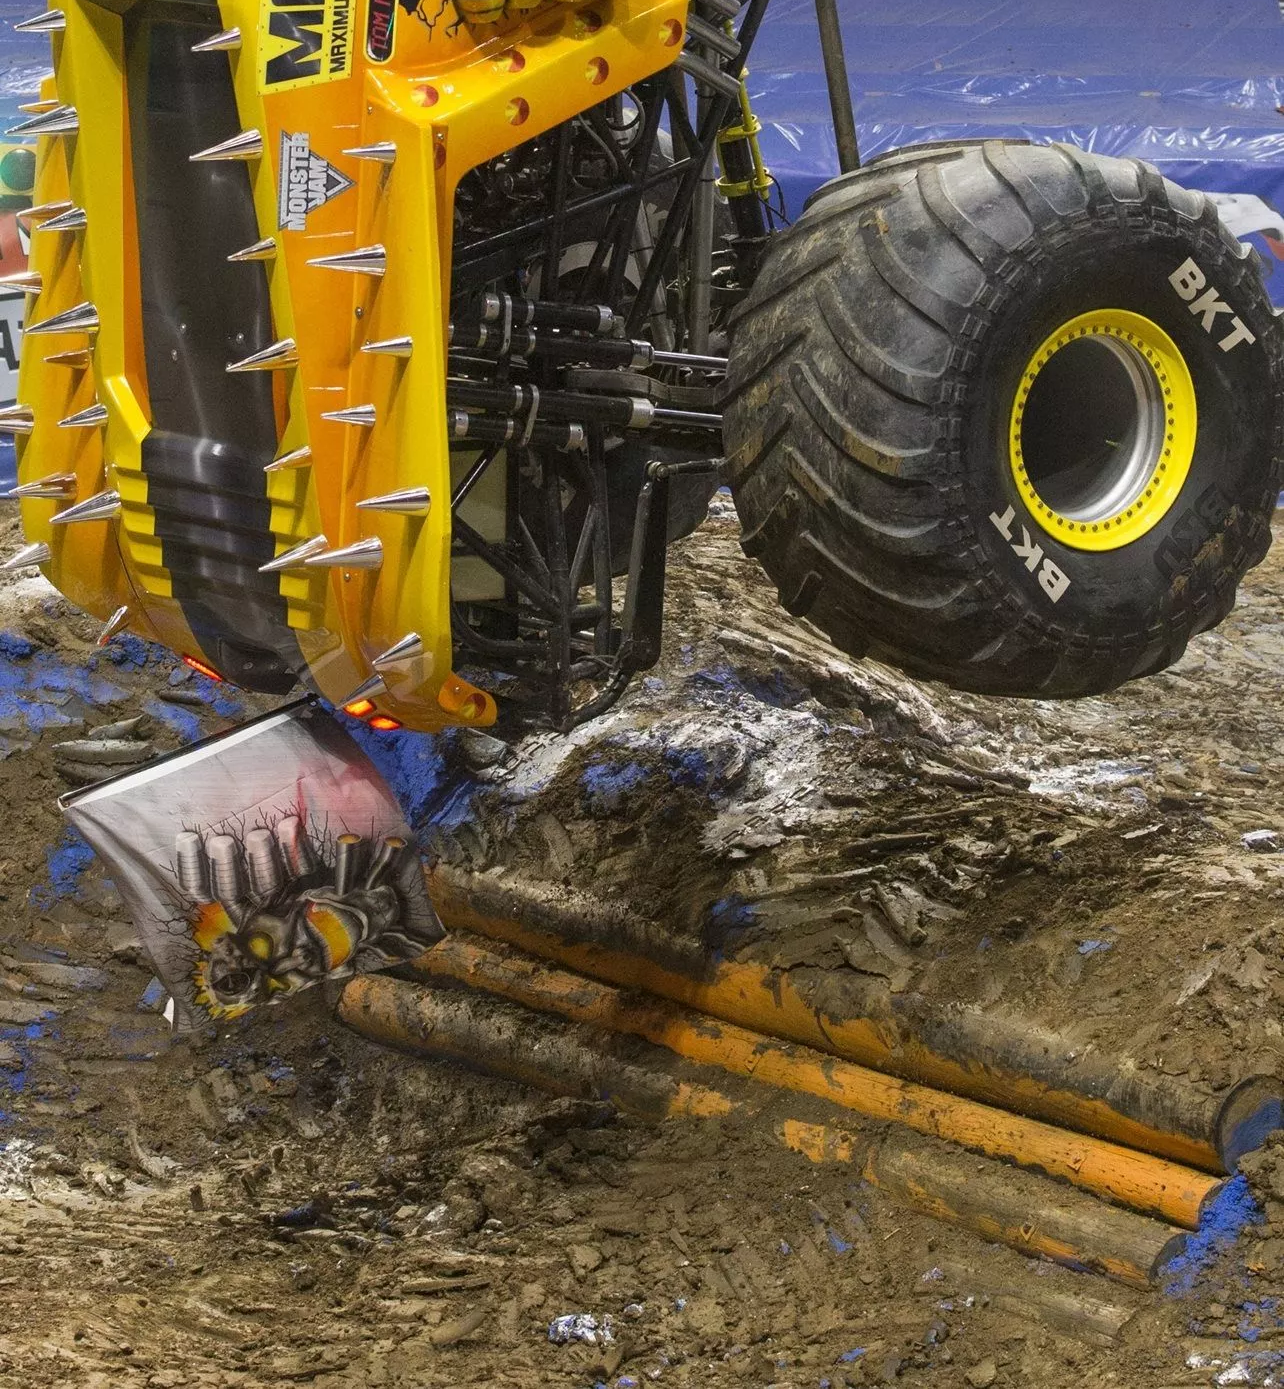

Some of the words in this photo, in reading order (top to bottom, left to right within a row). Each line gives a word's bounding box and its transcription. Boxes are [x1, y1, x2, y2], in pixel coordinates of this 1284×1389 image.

[370, 12, 390, 50] TOM
[287, 131, 310, 232] MONSTER
[307, 157, 328, 209] JAM
[1168, 256, 1257, 353] BKT
[989, 504, 1072, 604] BKT
